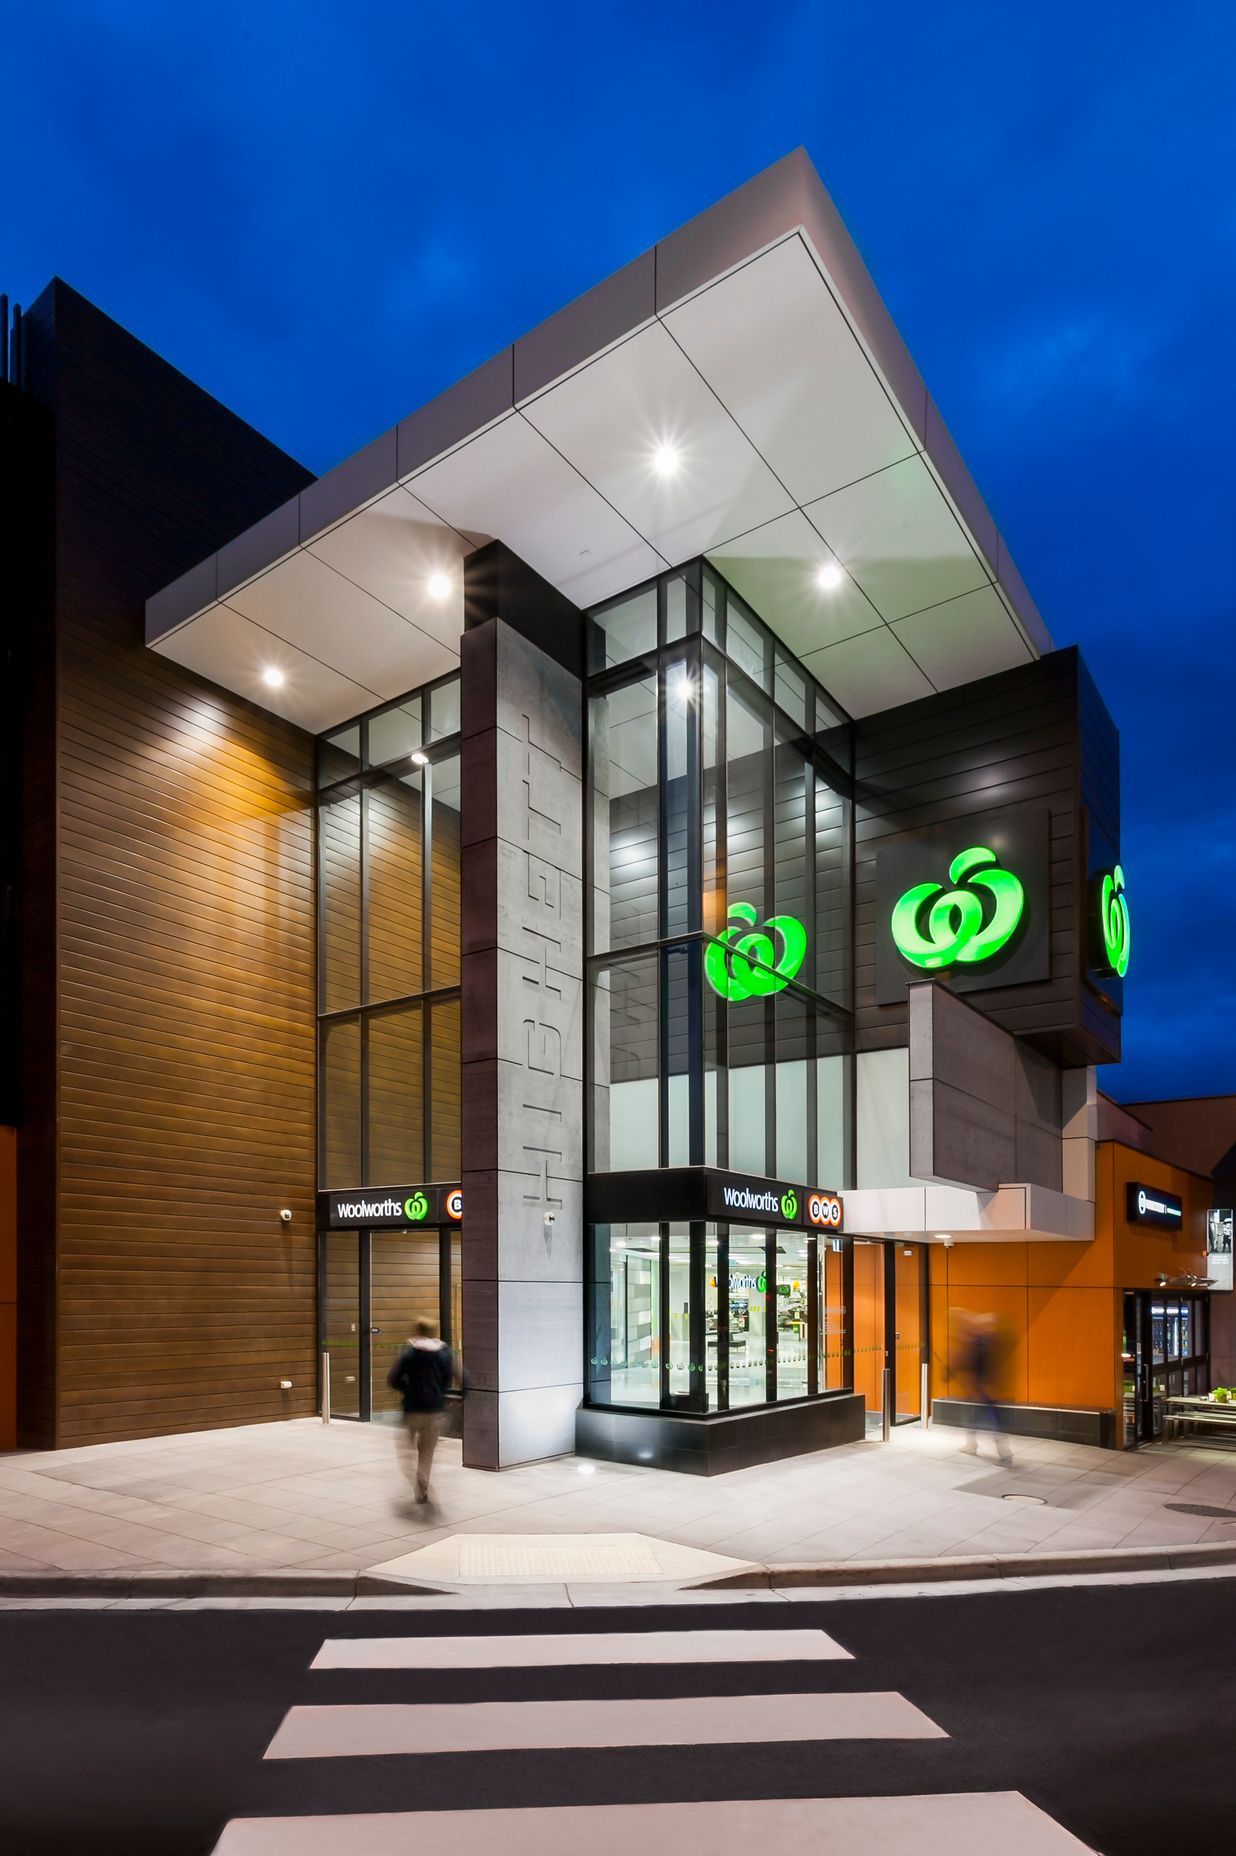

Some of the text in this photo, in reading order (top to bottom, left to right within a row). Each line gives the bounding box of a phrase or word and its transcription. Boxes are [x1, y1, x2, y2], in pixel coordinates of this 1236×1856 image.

[522, 712, 562, 1212] HIGHETT
[337, 1199, 402, 1218] Woolworths
[724, 1187, 779, 1212] Woolworths
[811, 1198, 841, 1222] BWS
